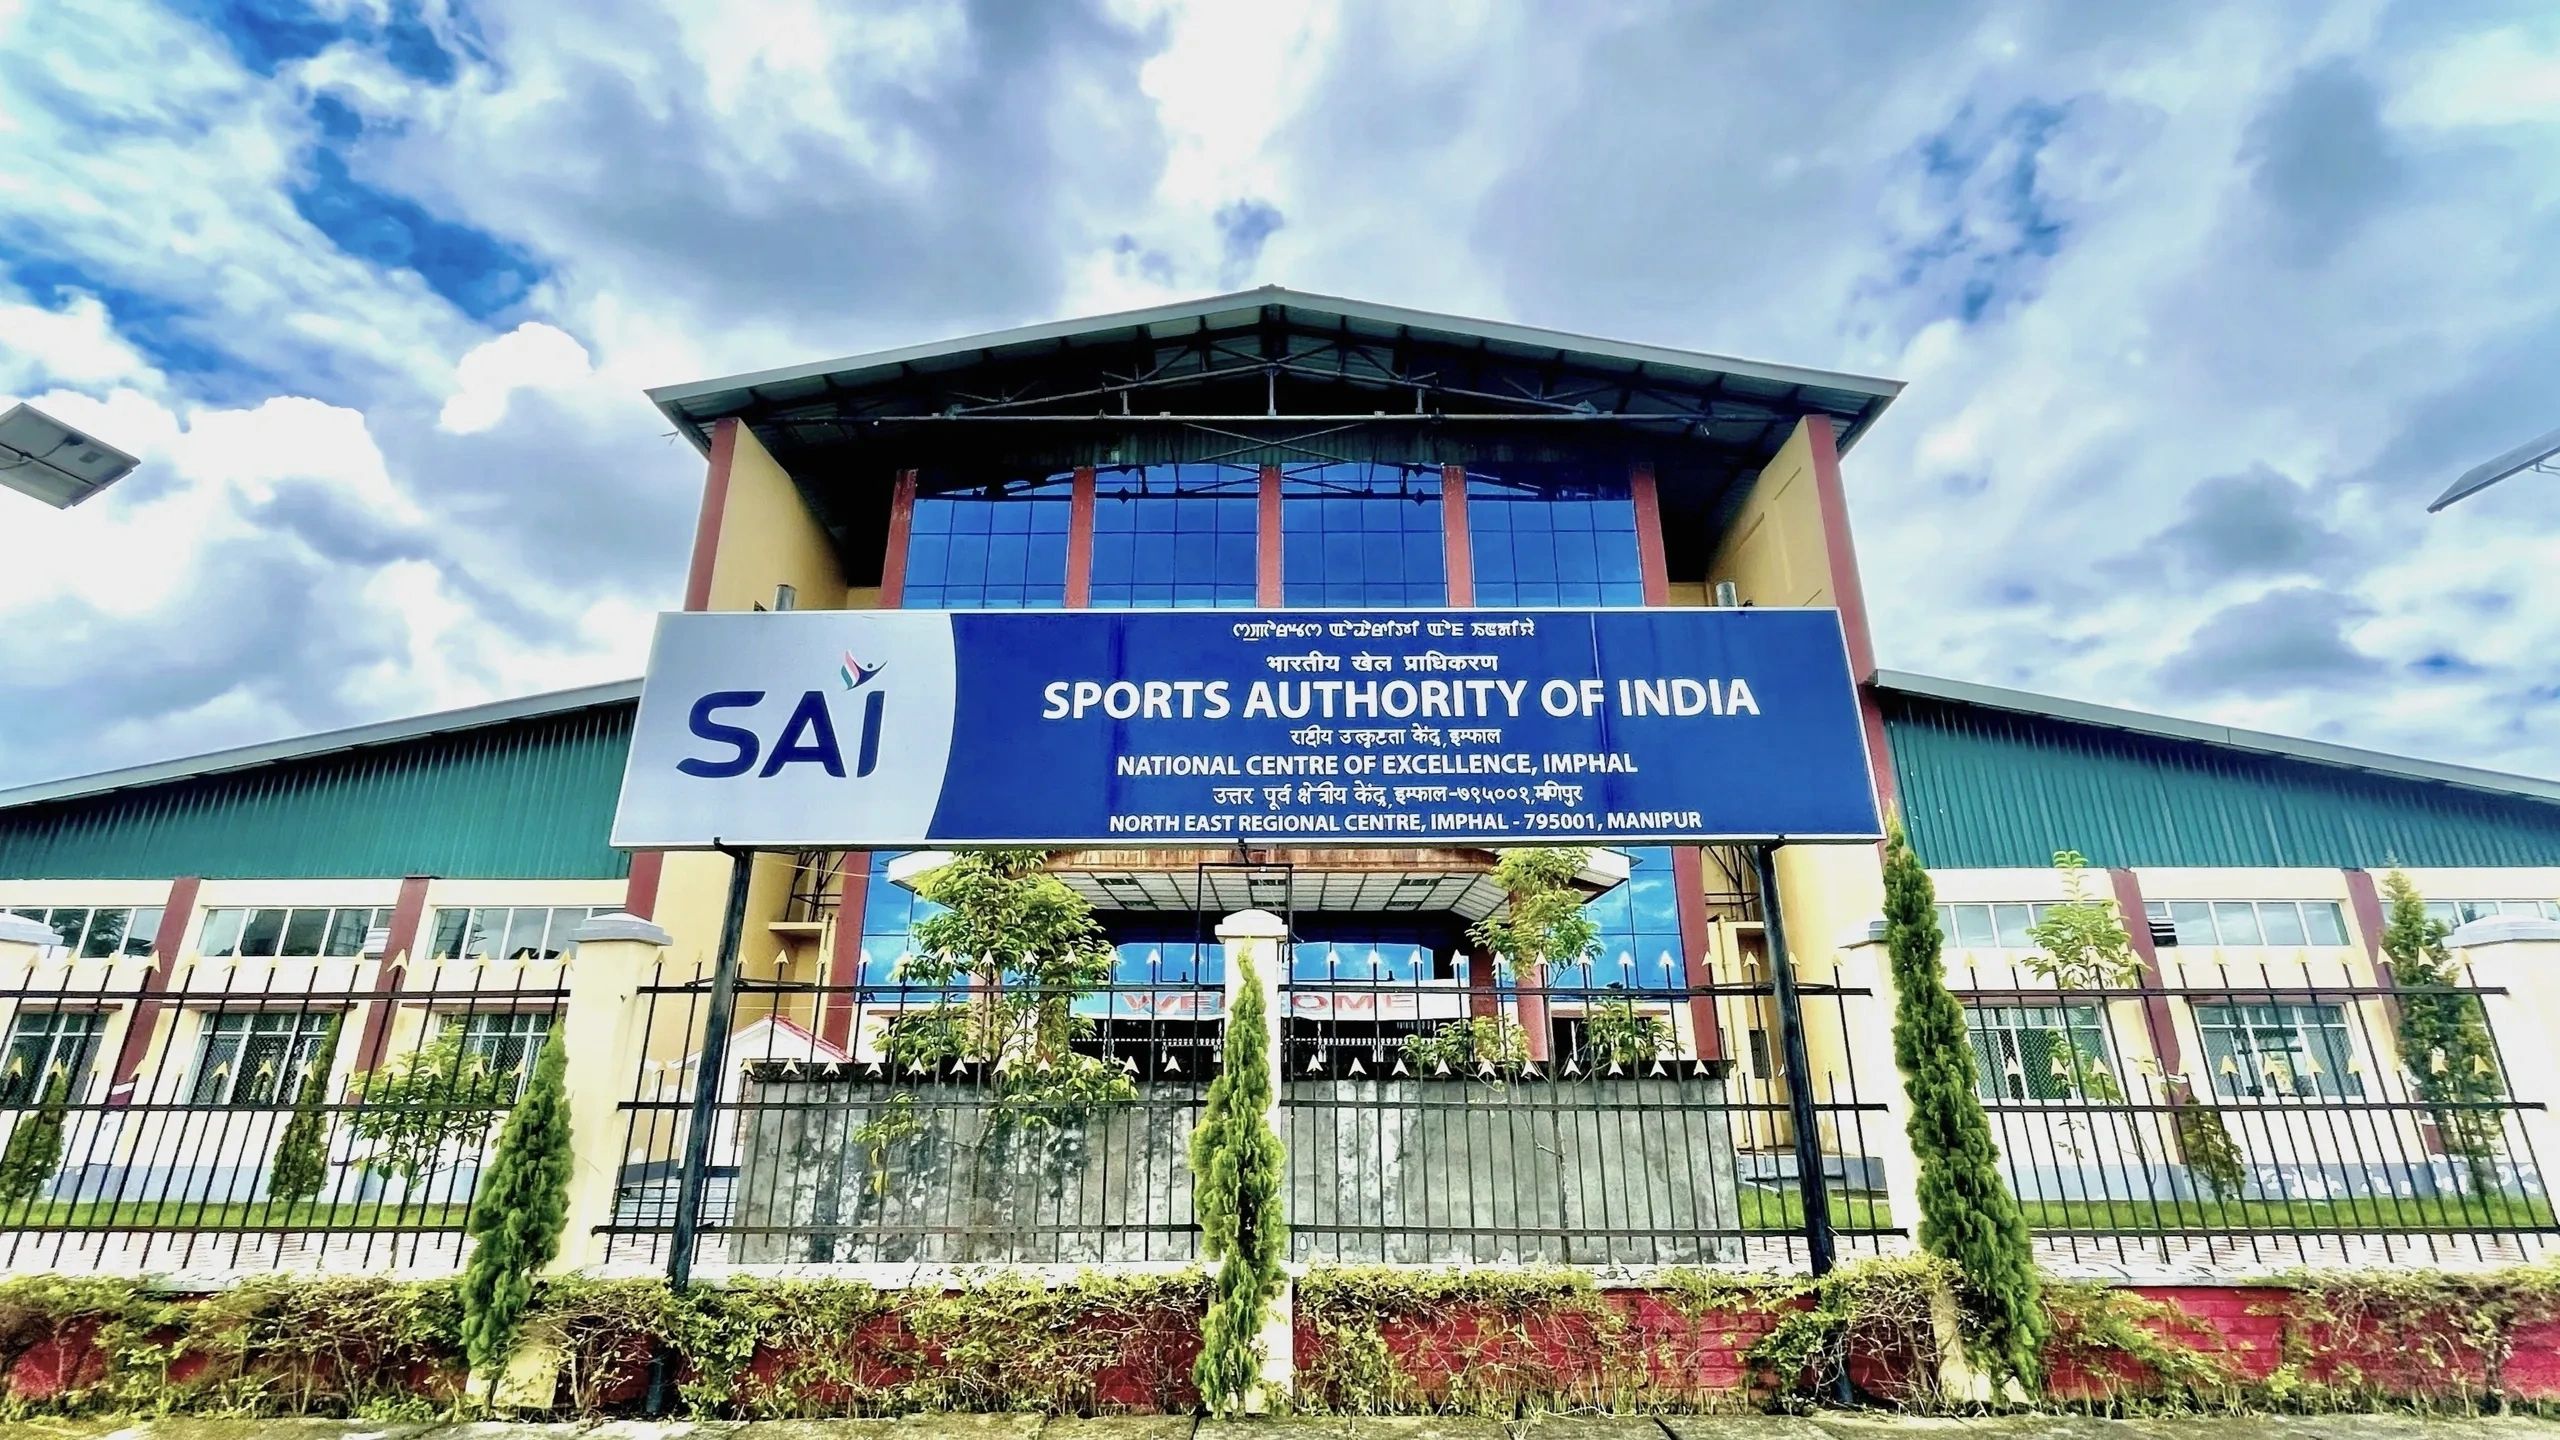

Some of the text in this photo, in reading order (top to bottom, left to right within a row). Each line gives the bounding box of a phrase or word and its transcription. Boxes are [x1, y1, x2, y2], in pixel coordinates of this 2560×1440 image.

[1266, 649, 1499, 673] भारतीय खेल प्राधिकरण
[1042, 678, 1761, 720] SPORTS AUTHORITY OF INDIA
[676, 690, 886, 778] SAI
[1117, 753, 1639, 777] NATIONAL CENTRE OF EXCELLENCE, IMPHAL
[1212, 787, 1255, 805] उत्तर
[1262, 783, 1293, 811] पूर्व
[1297, 780, 1349, 805] क्षेत्रीय
[1109, 814, 1180, 832] NORTH
[1184, 814, 1235, 832] EAST
[1238, 814, 1341, 832] REGIONAL
[1344, 813, 1427, 833] CENTRE,
[1430, 813, 1509, 831] IMPHAL
[1523, 813, 1603, 832] 795001,
[1607, 811, 1703, 829] MANIPUR
[1122, 993, 1416, 1015] WEOME
